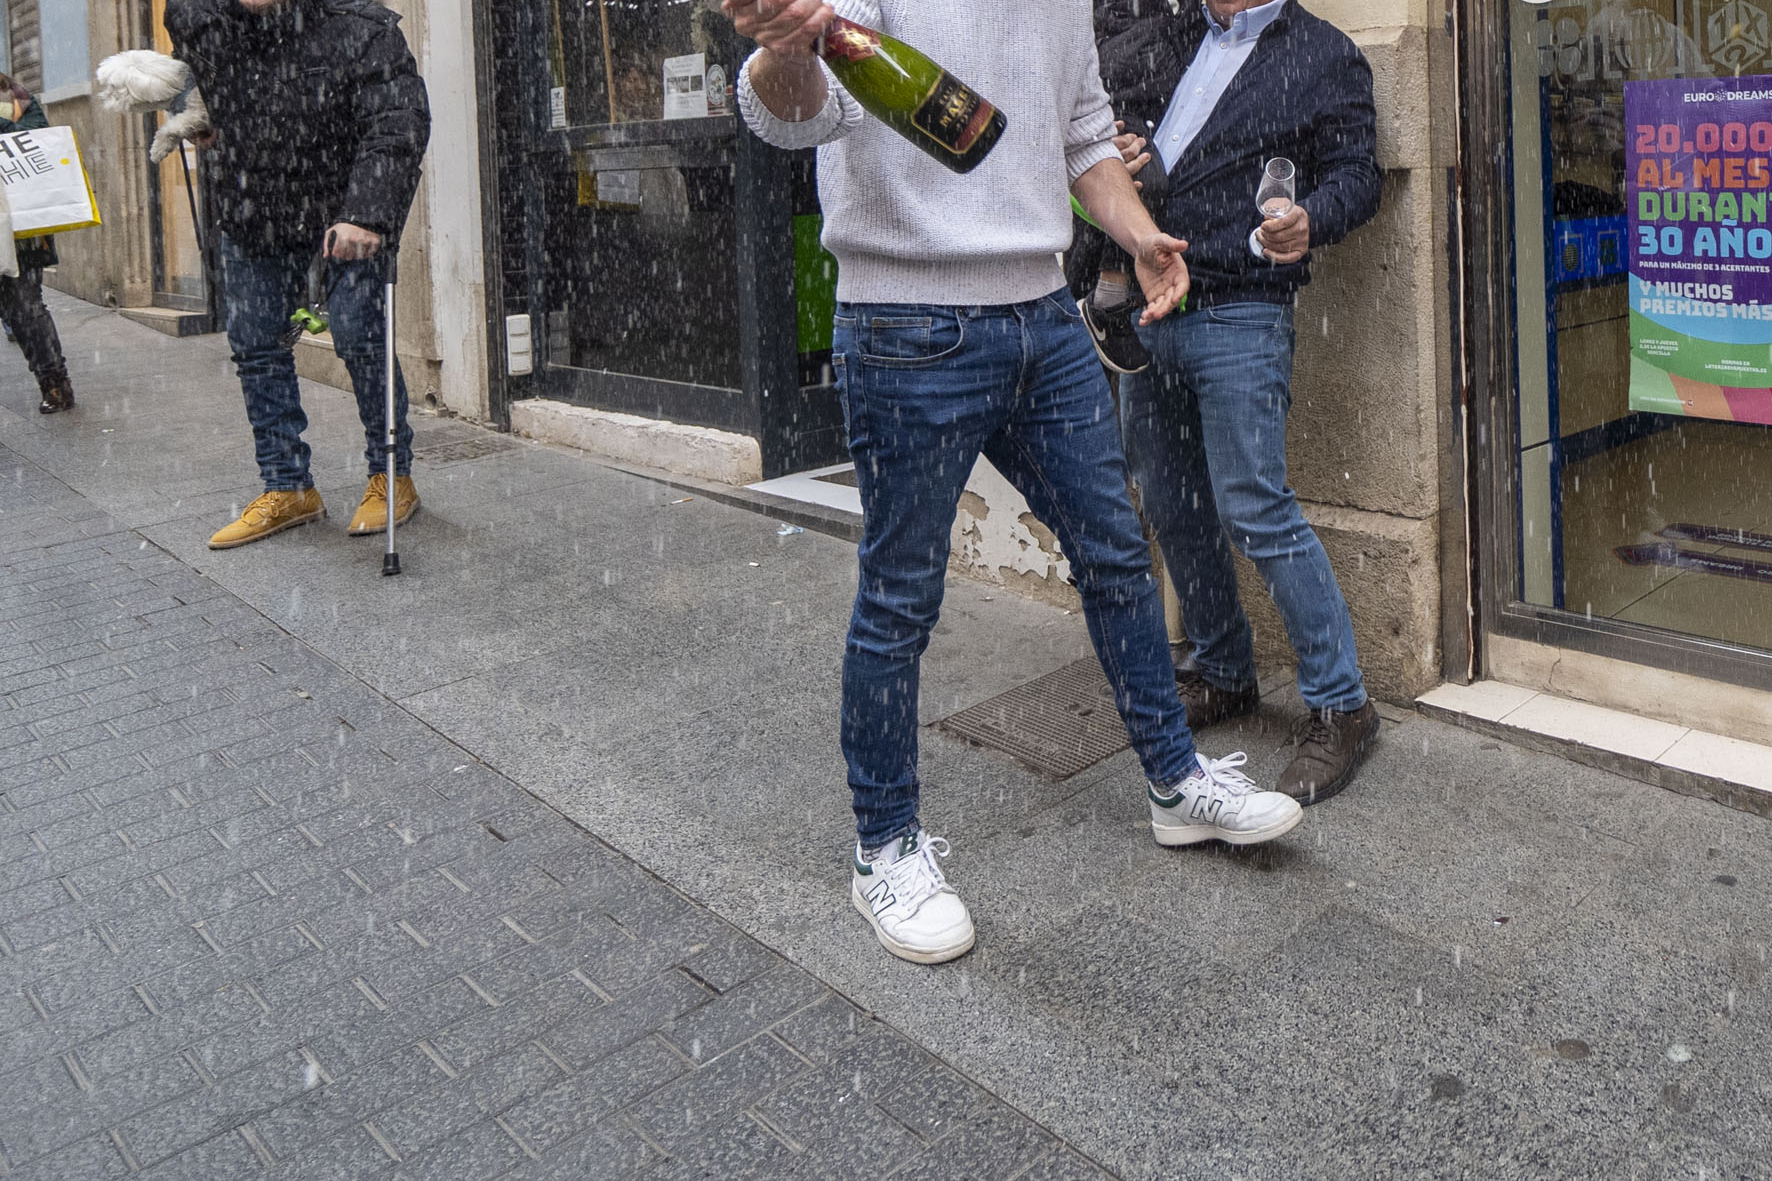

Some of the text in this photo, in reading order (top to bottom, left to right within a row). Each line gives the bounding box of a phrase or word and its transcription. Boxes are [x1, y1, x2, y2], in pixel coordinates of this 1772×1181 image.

[1684, 92, 1715, 103] EURO
[1637, 157, 1770, 188] AL MES
[1638, 225, 1683, 256] 30
[1639, 261, 1658, 269] PARA
[1660, 261, 1670, 270] UN
[1704, 263, 1714, 271] DE
[1715, 264, 1720, 272] 3
[1720, 263, 1770, 273] ACERTANTES
[1639, 281, 1734, 301] Y MUCHOS
[1640, 297, 1727, 318] PREMIOS
[866, 879, 897, 917] N
